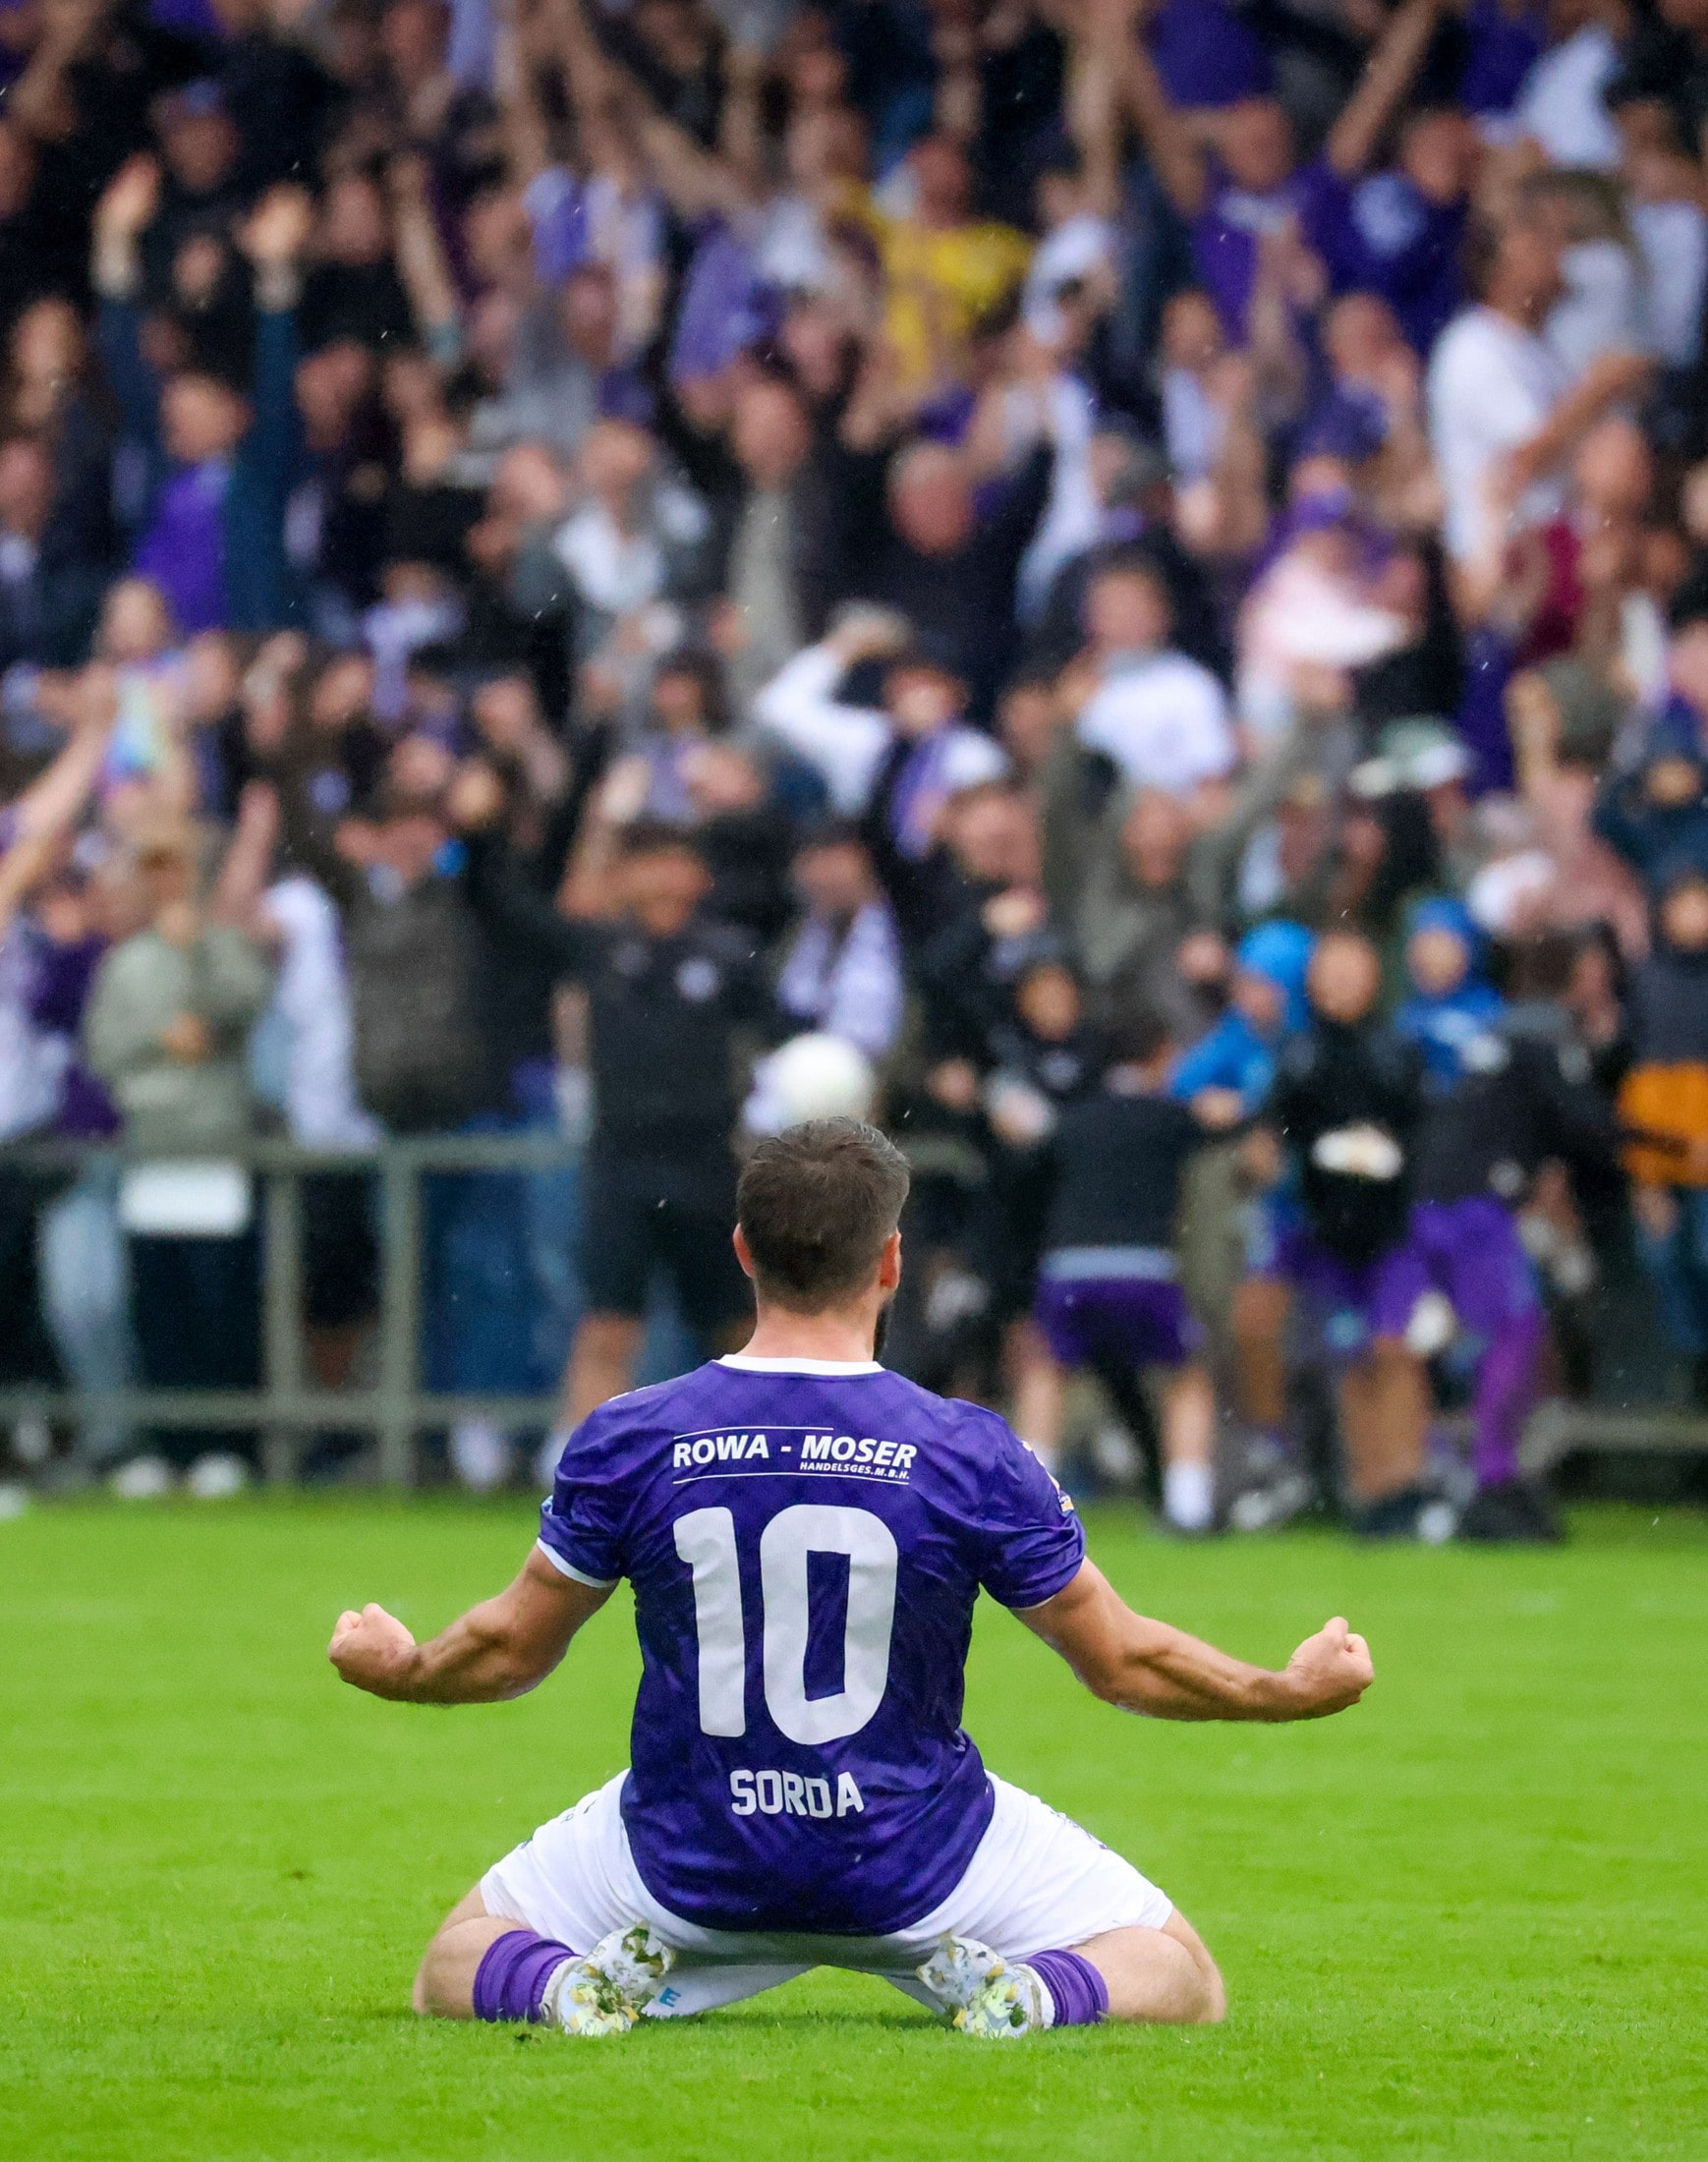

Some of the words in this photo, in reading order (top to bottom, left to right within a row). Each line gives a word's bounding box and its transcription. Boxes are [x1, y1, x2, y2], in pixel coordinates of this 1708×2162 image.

[673, 1435, 769, 1467] ROWA
[801, 1436, 917, 1468] MOSER
[799, 1461, 910, 1479] HANDELSGES.M.B.H.
[673, 1504, 898, 1745] 10
[730, 1770, 865, 1818] SORDA
